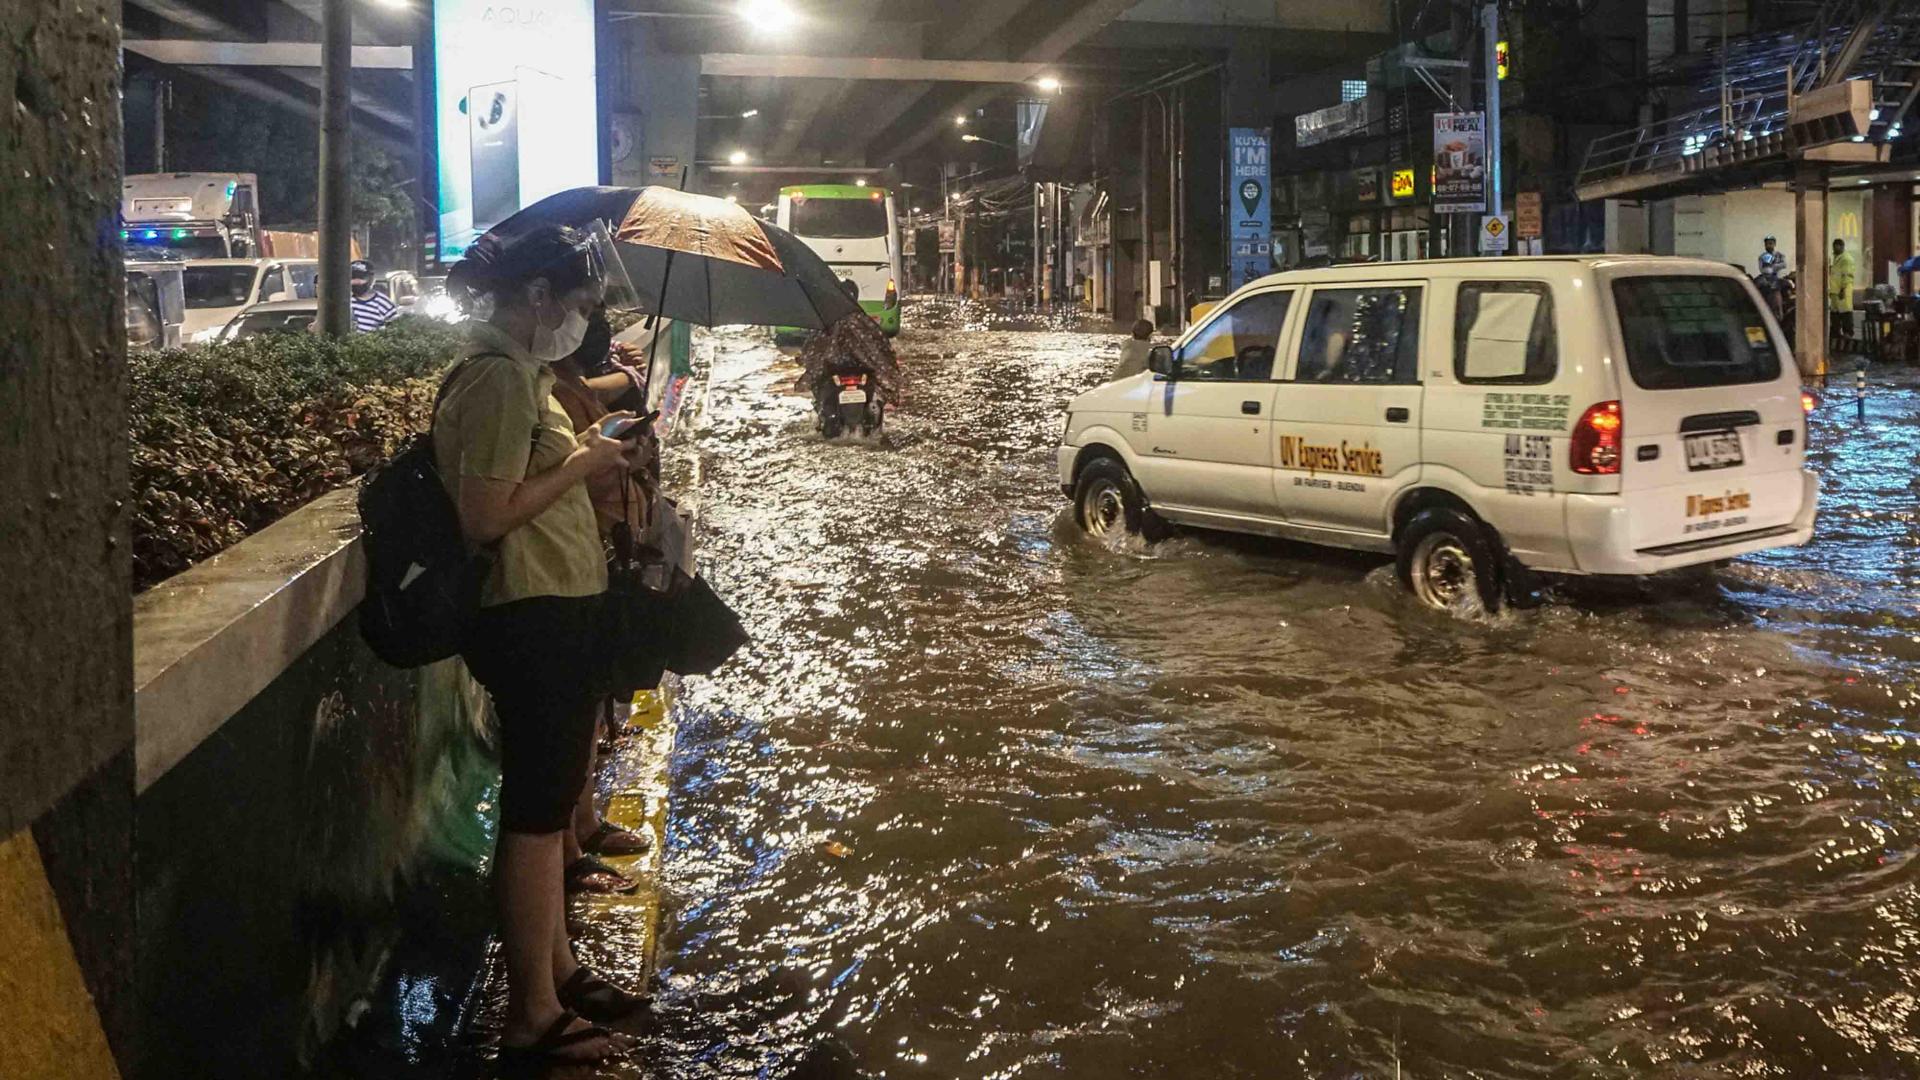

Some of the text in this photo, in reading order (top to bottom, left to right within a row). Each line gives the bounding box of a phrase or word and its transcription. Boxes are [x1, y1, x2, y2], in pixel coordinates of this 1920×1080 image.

[1234, 135, 1266, 147] KUYA
[1234, 146, 1267, 165] I'M
[1234, 165, 1267, 177] HERE
[1298, 437, 1339, 477] Express
[1341, 440, 1383, 475] Service
